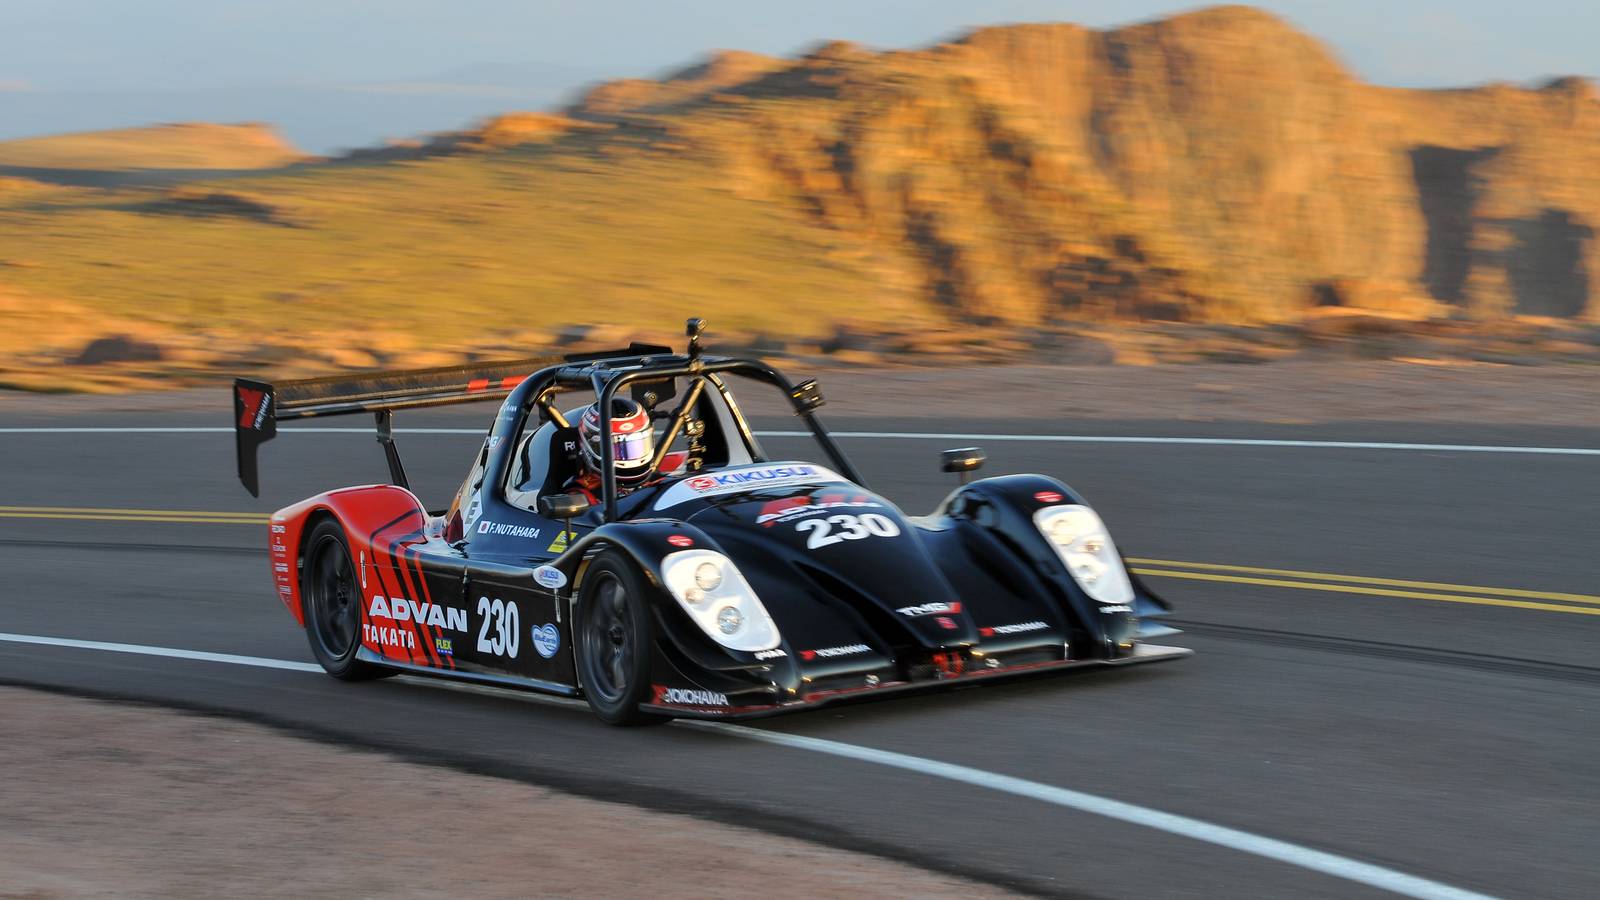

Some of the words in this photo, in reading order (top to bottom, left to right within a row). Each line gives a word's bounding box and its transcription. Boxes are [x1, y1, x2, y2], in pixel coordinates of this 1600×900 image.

[714, 466, 816, 485] KIKUSUI
[488, 522, 541, 539] F.NUTAHARA
[795, 513, 900, 550] 230
[368, 595, 469, 633] ADVAN
[363, 624, 416, 650] TAKATA
[477, 596, 520, 659] 230
[436, 638, 452, 650] FLEX
[664, 687, 730, 706] YOKOHAMA
